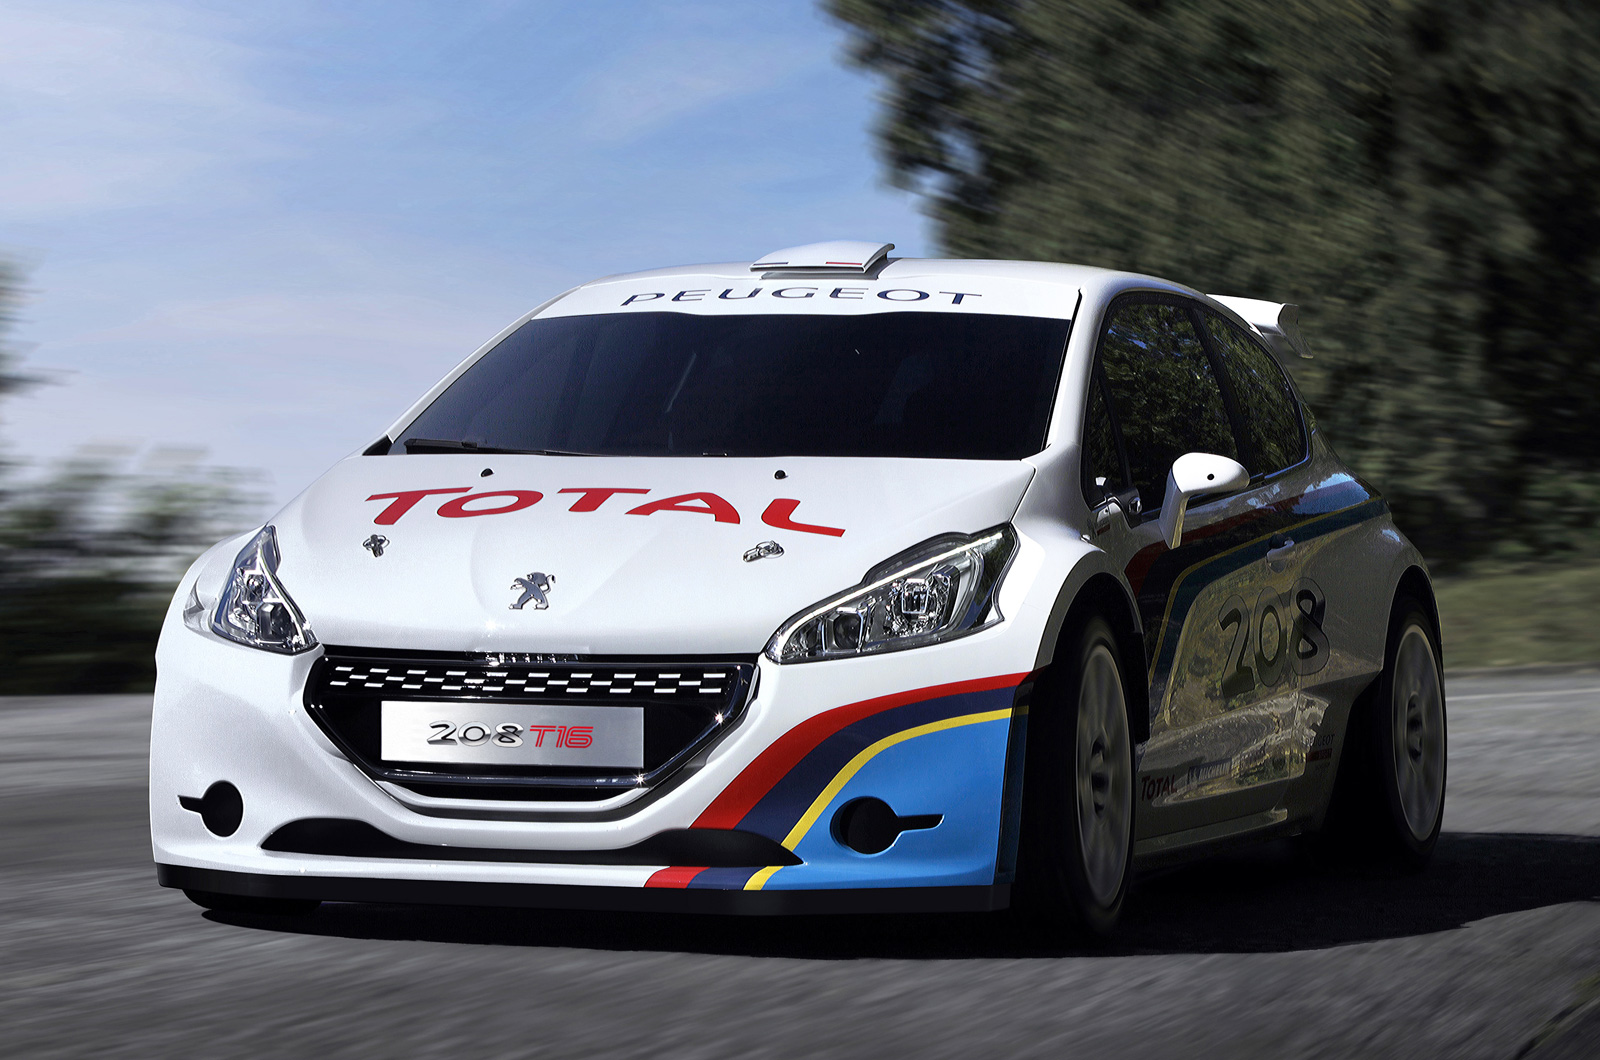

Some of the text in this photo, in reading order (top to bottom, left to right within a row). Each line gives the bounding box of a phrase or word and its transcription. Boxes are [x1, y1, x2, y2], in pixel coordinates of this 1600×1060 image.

[620, 287, 982, 307] PEUGEOT
[365, 487, 846, 537] TOTAL
[1218, 577, 1330, 699] 208
[426, 720, 594, 749] 208 T16
[1140, 774, 1177, 801] TOTAL
